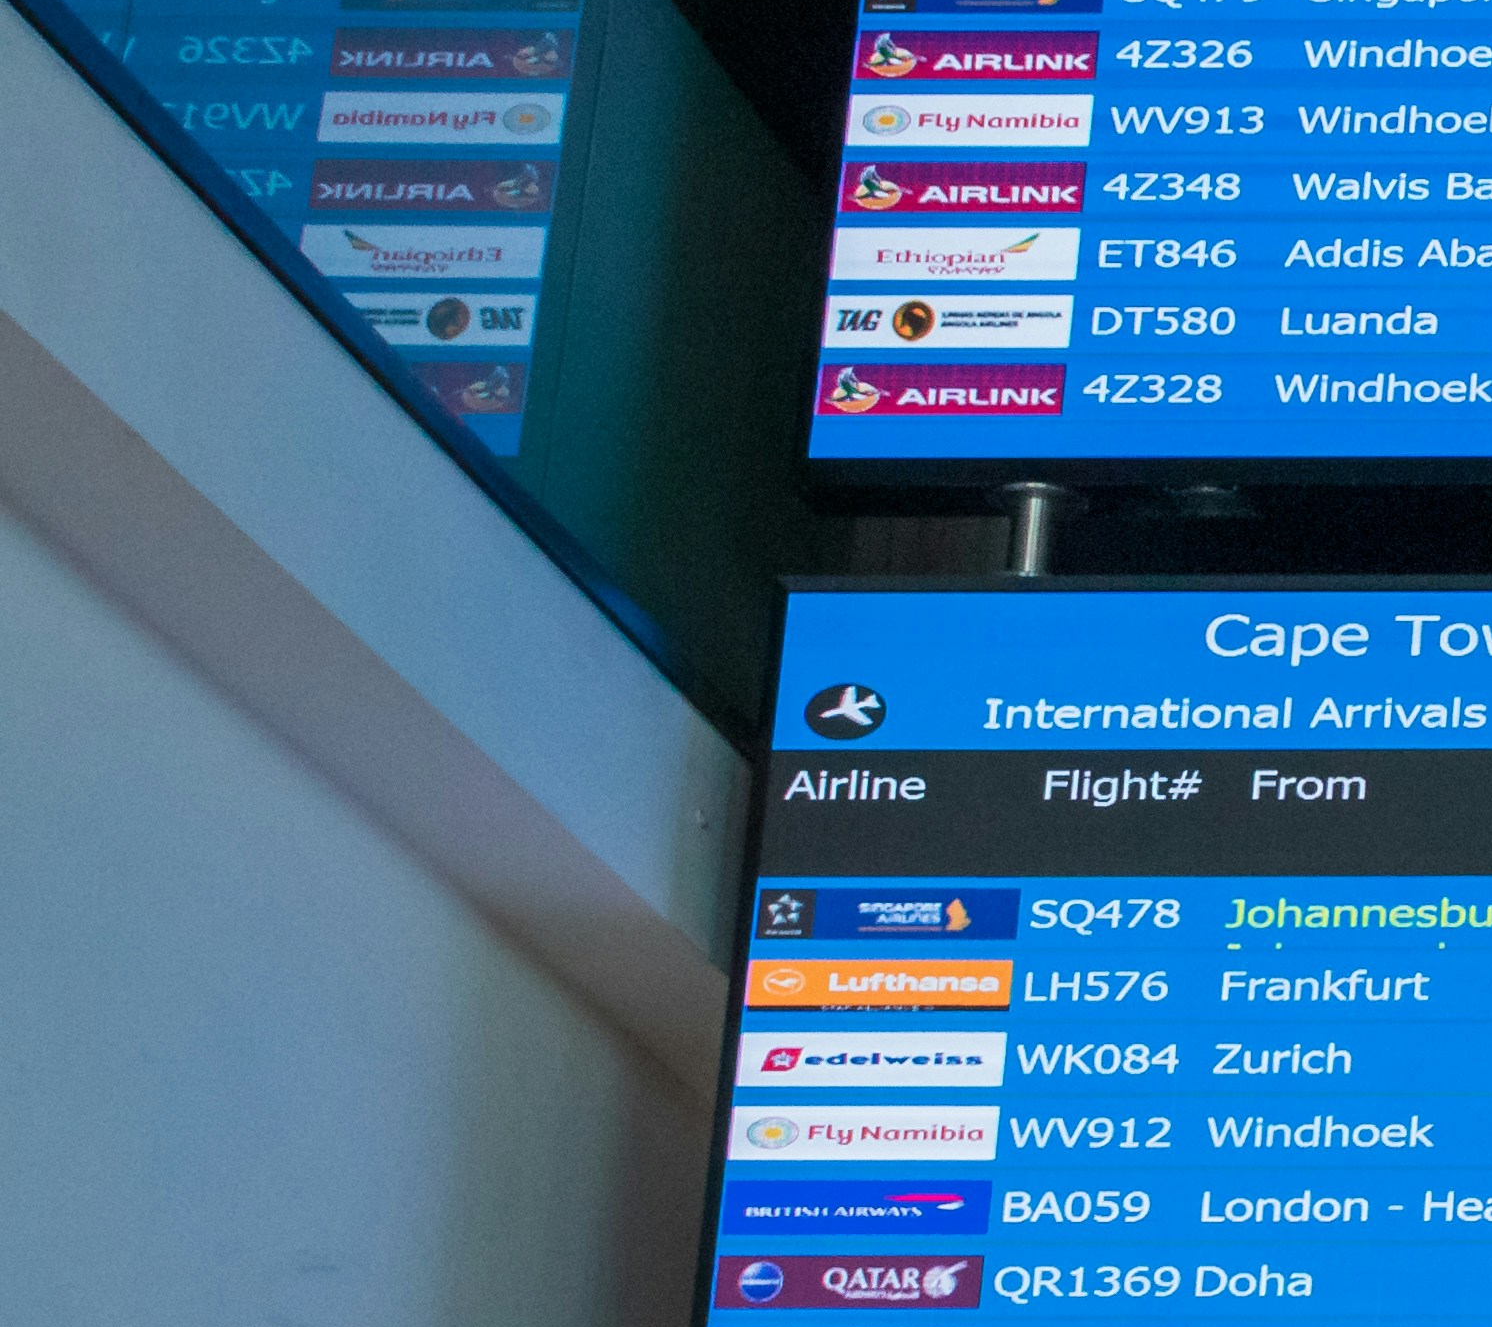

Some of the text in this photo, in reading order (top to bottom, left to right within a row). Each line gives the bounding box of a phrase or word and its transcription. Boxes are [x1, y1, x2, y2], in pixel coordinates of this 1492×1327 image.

[918, 113, 960, 131] Fly
[966, 113, 1079, 128] Namibia
[1111, 107, 1263, 133] WV913
[876, 249, 1006, 267] Ethiopian
[1099, 240, 1236, 267] ET846
[1285, 239, 1403, 267] Addis
[1206, 615, 1368, 666] Cape
[984, 697, 1486, 728] International Arrivals
[828, 973, 999, 992] Lufthansa
[1025, 972, 1168, 1001] LH576
[1222, 970, 1429, 1000] Frankfurt
[805, 1053, 983, 1065] edelweiss
[1017, 1044, 1178, 1074] WK084
[1213, 1043, 1351, 1074] Zurich
[823, 1267, 920, 1292] QATAR
[995, 1266, 1180, 1303] QR1369
[1196, 1265, 1312, 1296] Doha
